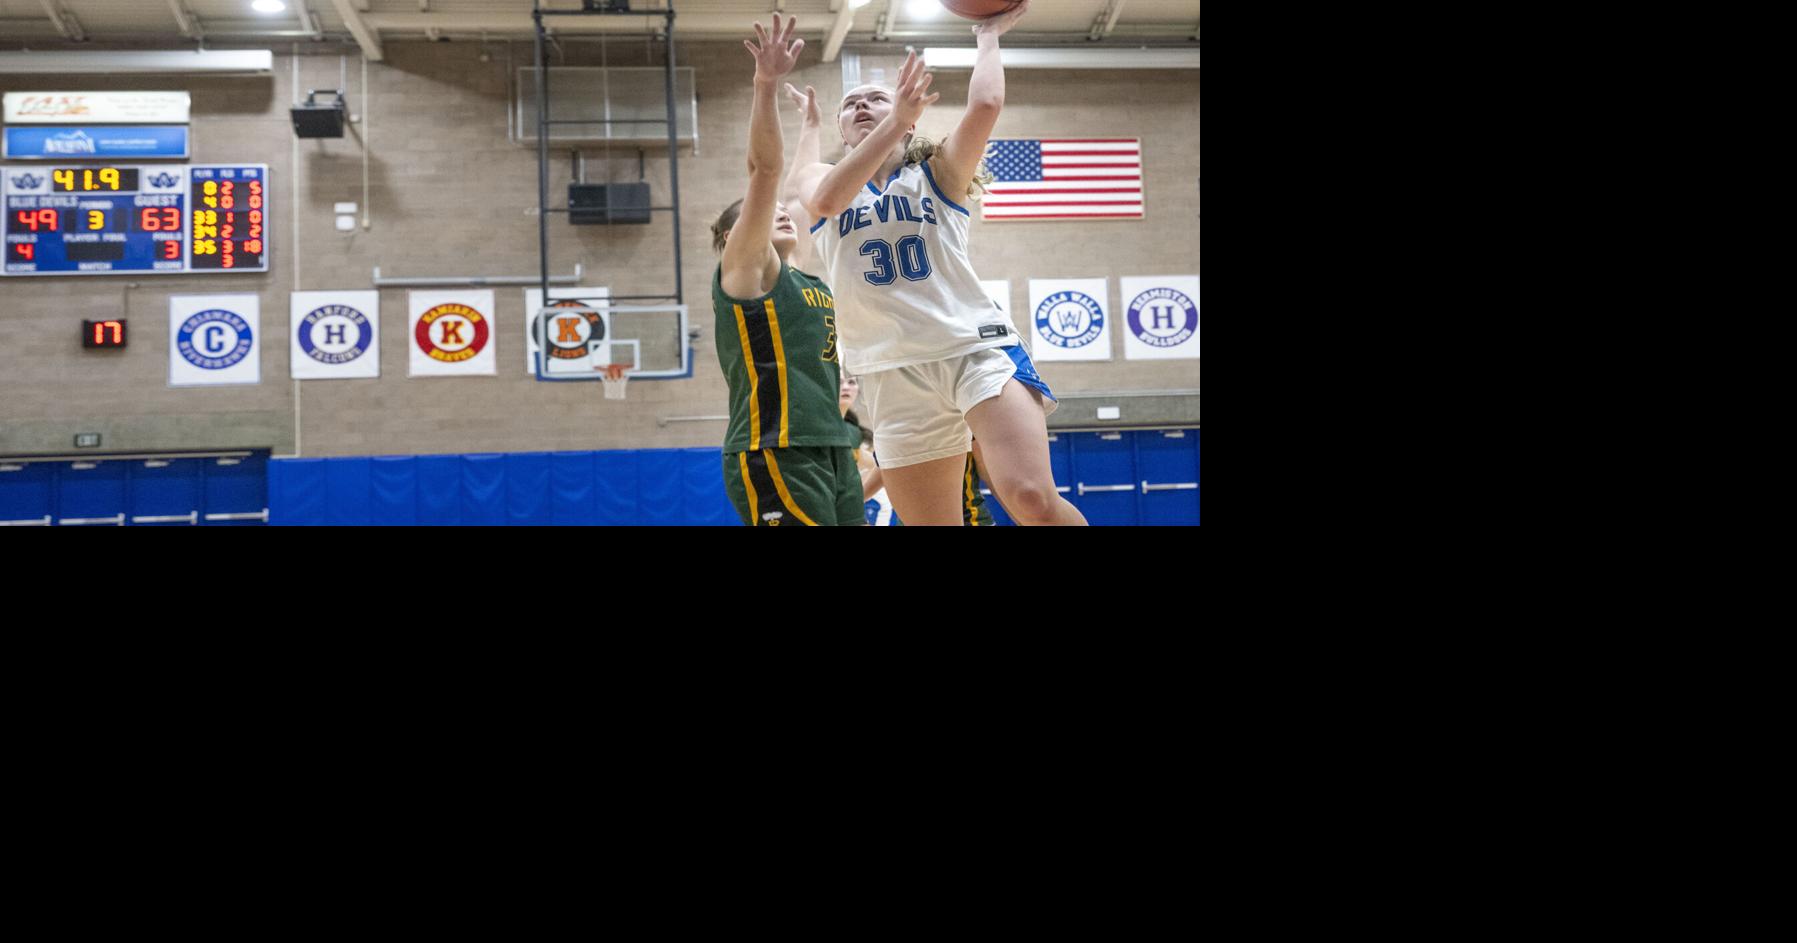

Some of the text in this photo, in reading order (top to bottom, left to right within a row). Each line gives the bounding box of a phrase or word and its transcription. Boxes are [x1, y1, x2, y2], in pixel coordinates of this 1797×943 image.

[53, 168, 120, 191] 41.9
[221, 181, 234, 195] 2
[249, 181, 262, 195] 5
[9, 196, 79, 208] BLUE DEVILS
[133, 195, 179, 207] GUEST
[220, 195, 234, 209] 0
[249, 195, 262, 209] 0
[17, 208, 59, 232] 49
[88, 209, 105, 231] 3
[140, 207, 182, 232] 63
[249, 209, 262, 224] 0
[839, 194, 938, 238] DEVILS
[221, 223, 234, 239] 2
[249, 223, 262, 238] 2
[16, 243, 34, 260] 4
[164, 240, 181, 260] 3
[221, 239, 234, 254] 3
[221, 254, 234, 268] 3
[858, 234, 933, 287] 30
[1037, 292, 1102, 320] WALLA WALLA
[1130, 288, 1193, 312] HERMISTON
[1150, 305, 1176, 330] H
[94, 320, 122, 345] 17
[205, 325, 224, 353] C
[324, 324, 346, 345] H
[440, 320, 465, 345] K
[556, 317, 582, 342] K
[1039, 325, 1101, 348] BLUE DEVILS
